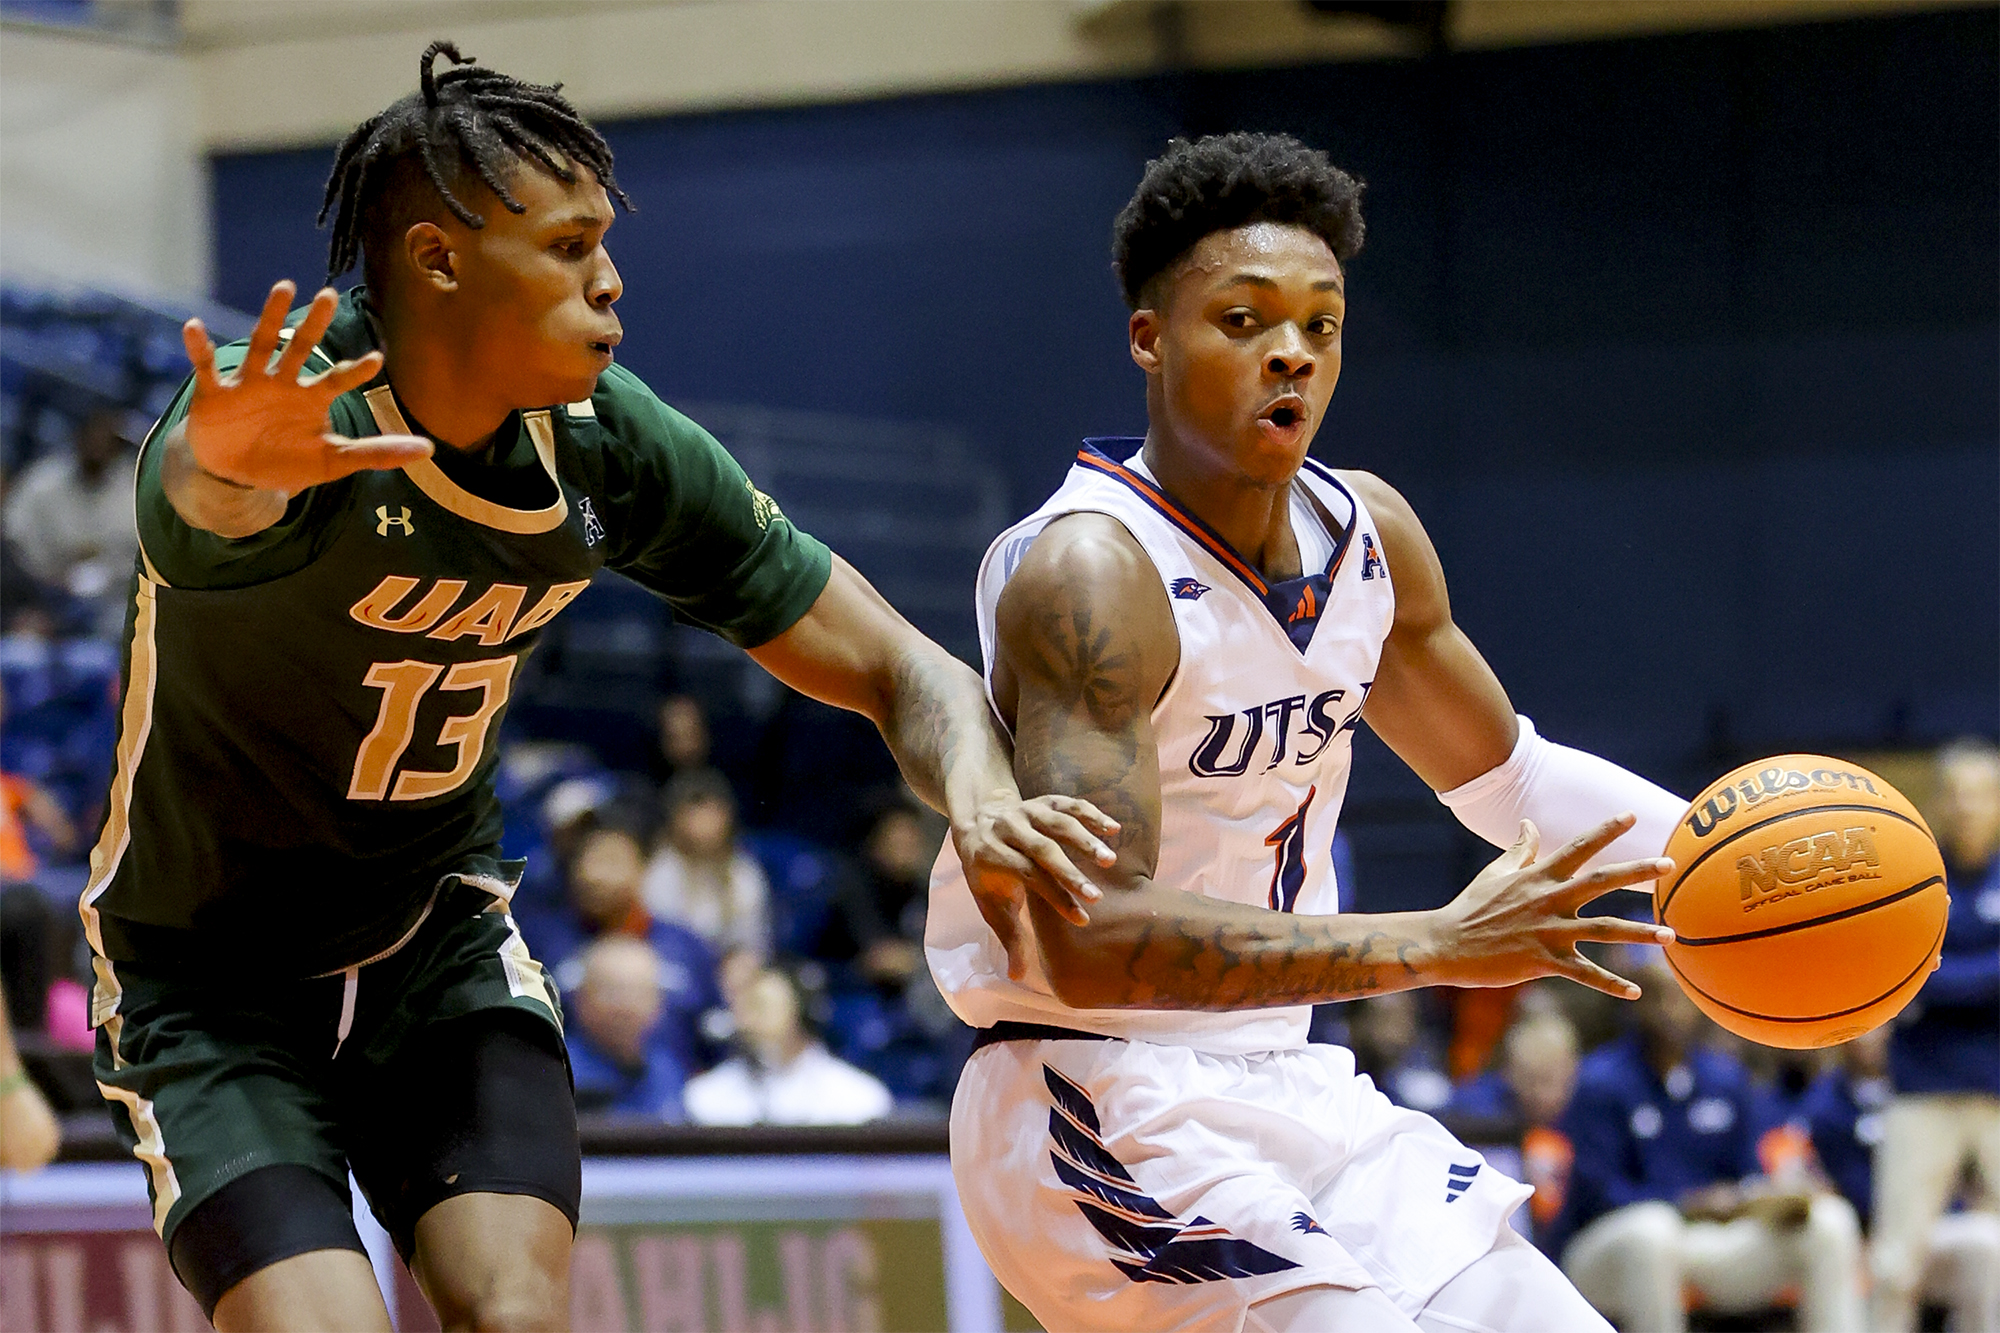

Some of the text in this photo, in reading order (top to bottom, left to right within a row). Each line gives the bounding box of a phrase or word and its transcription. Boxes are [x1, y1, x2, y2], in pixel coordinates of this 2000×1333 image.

[349, 575, 591, 645] UAB
[346, 655, 518, 801] 13
[1686, 767, 1881, 838] Wilson
[1264, 784, 1316, 913] 1
[1736, 827, 1881, 901] NCAA
[1743, 871, 1882, 913] OFFICIAL GAME BALL
